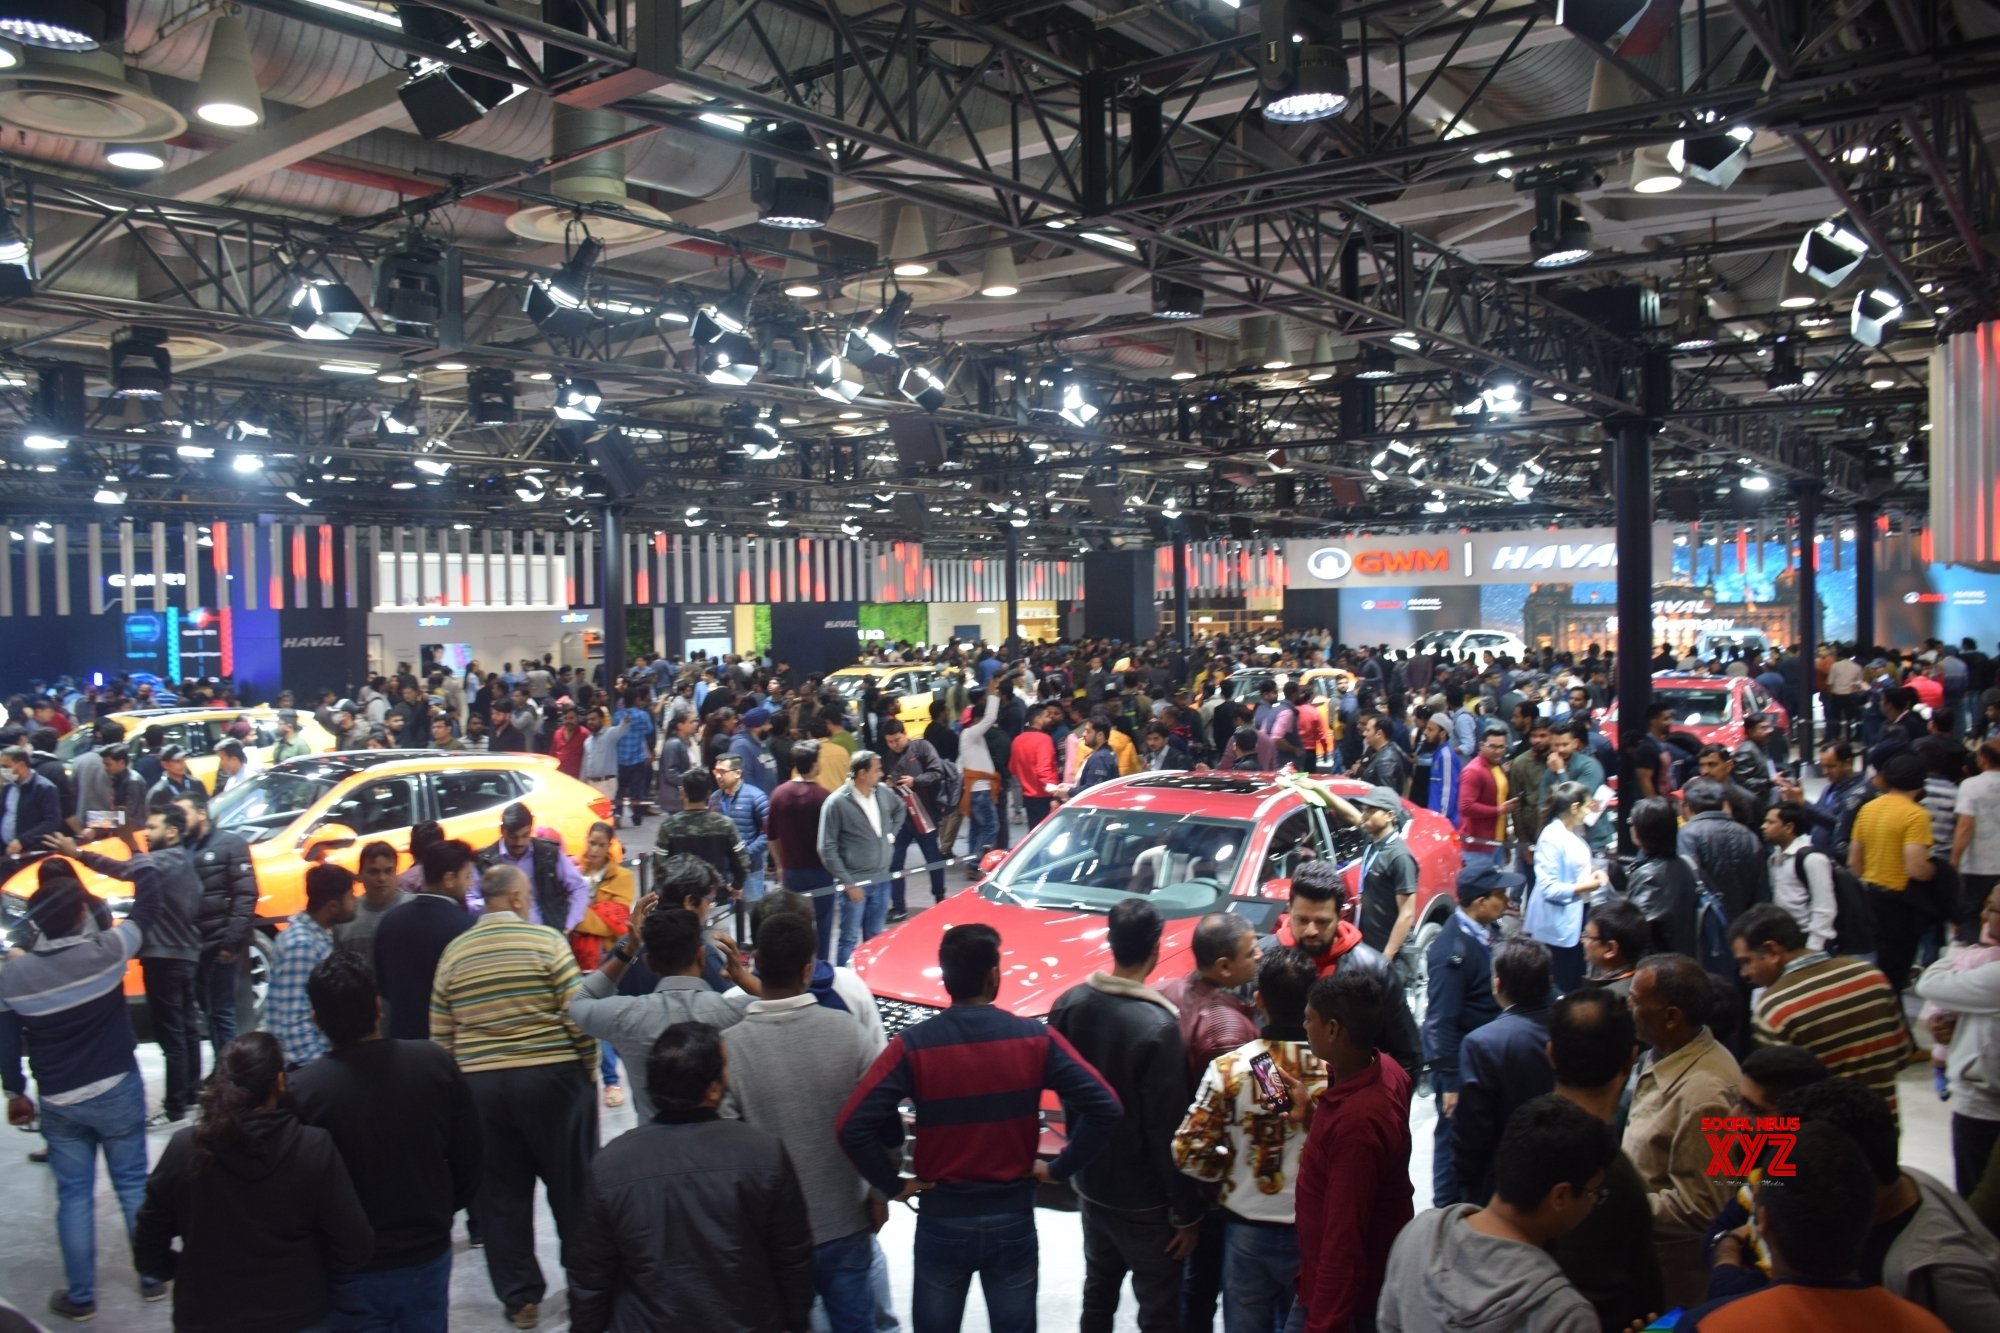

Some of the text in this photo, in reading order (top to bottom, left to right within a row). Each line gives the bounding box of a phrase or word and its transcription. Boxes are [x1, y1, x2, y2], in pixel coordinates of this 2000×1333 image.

[1353, 543, 1619, 574] GWM HAVA
[1650, 600, 1712, 614] AVAL
[282, 636, 345, 648] HAVAL
